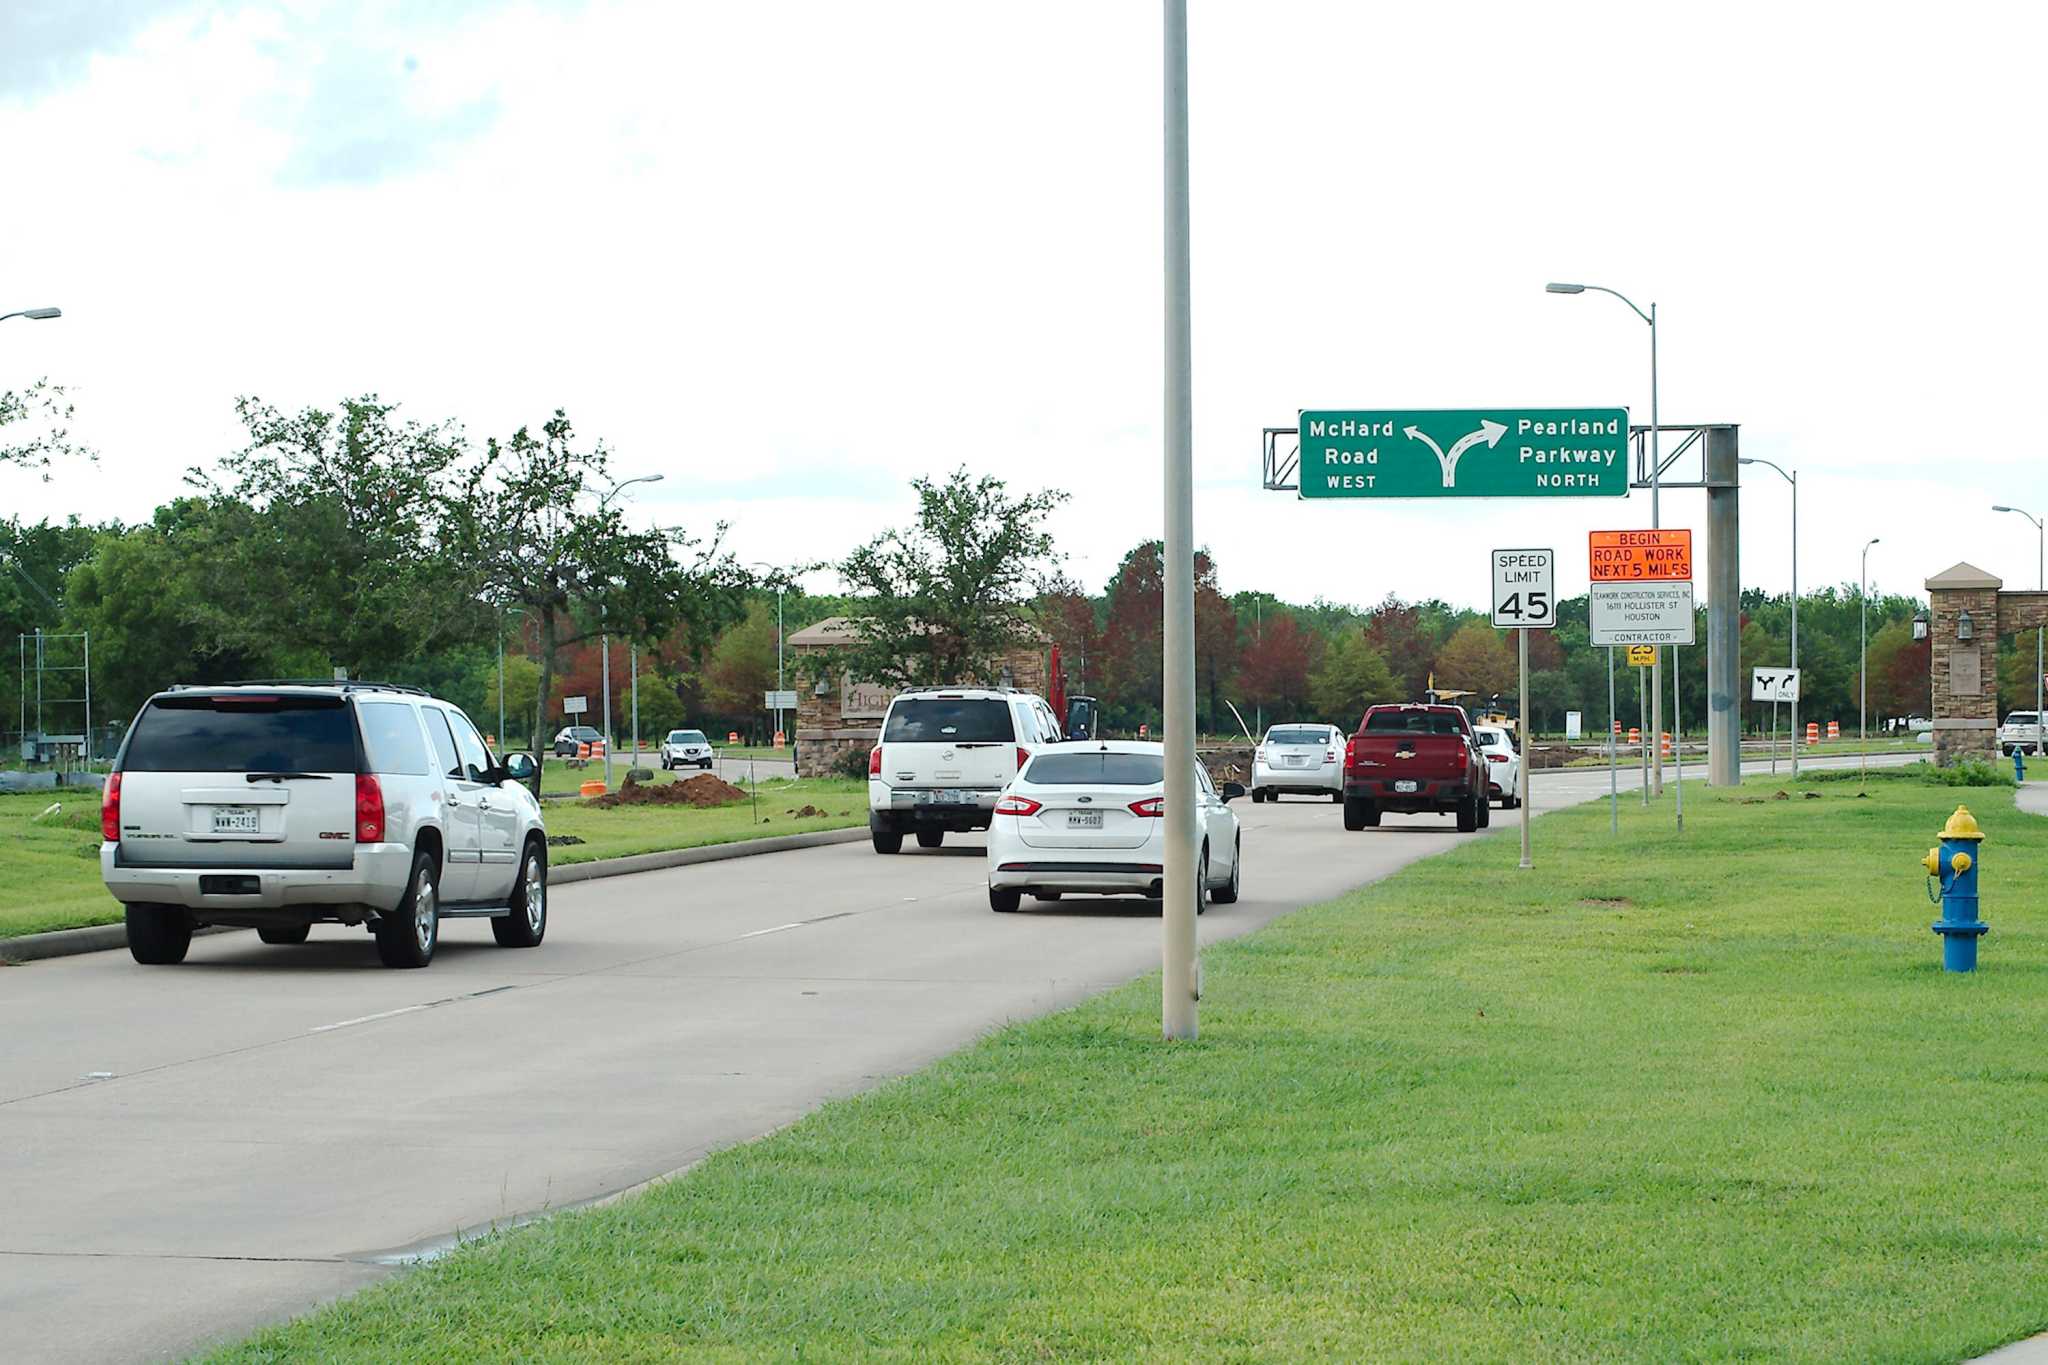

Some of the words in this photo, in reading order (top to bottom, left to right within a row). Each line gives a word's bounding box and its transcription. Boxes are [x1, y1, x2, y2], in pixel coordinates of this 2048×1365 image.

[1310, 420, 1393, 436] McHard
[1518, 419, 1618, 435] Pearland
[1325, 447, 1378, 464] Road
[1520, 447, 1617, 467] Parkway
[1327, 475, 1376, 488] WEST
[1537, 474, 1600, 487] NORTH
[1619, 533, 1660, 545] BEGIN
[1499, 554, 1547, 567] SPEED
[1594, 549, 1633, 561] ROAD
[1644, 548, 1684, 560] WORK
[1593, 564, 1628, 577] NEXT
[1632, 563, 1642, 577] 5
[1648, 563, 1689, 576] MILES
[1505, 571, 1541, 583] LIMIT
[1498, 592, 1549, 619] 45
[1624, 601, 1665, 610] HOLLISTER
[1668, 601, 1678, 609] ST
[1624, 613, 1660, 621] HOUSTON
[1614, 633, 1671, 642] CONTRACTOR
[1778, 690, 1794, 698] ONLY
[319, 831, 350, 840] GMC
